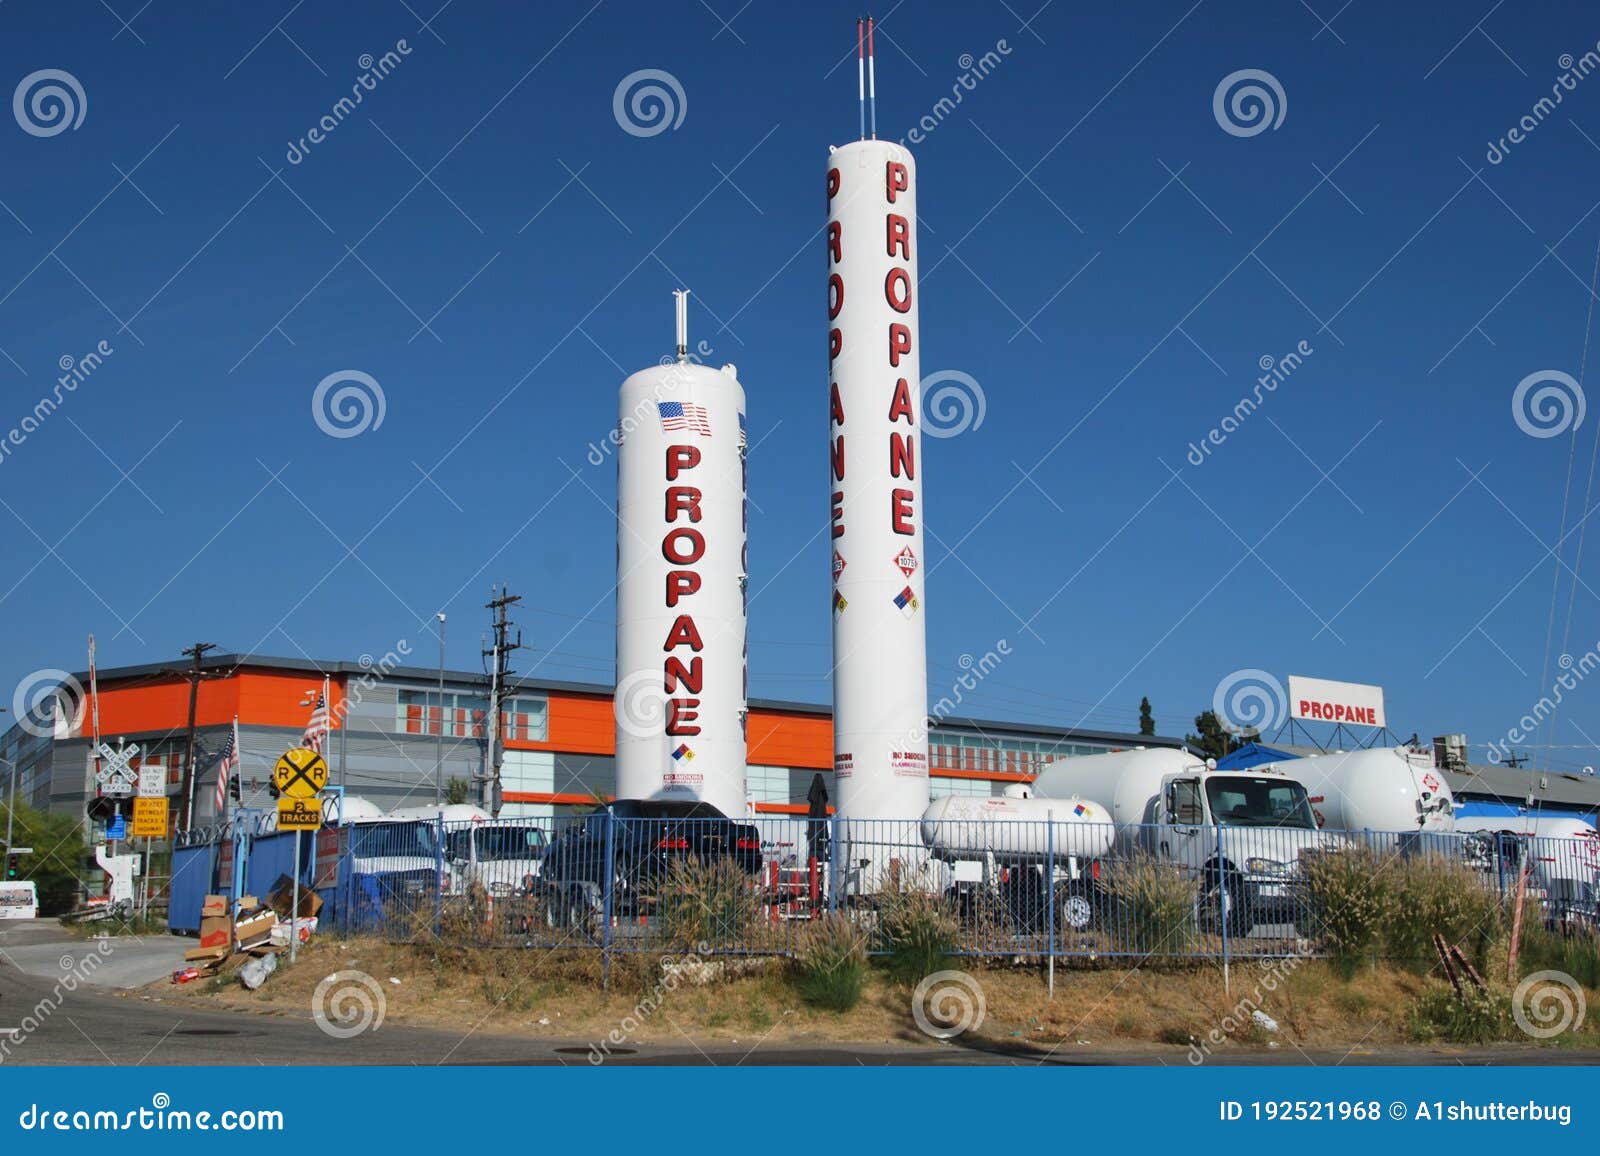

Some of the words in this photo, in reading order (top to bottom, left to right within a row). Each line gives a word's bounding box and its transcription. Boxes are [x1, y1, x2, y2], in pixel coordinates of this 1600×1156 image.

[885, 160, 916, 537] PROPANE
[900, 557, 915, 568] 1075
[661, 444, 706, 738] PROPANE
[1299, 700, 1377, 725] PROPANE
[278, 767, 290, 780] R
[313, 767, 324, 780] R
[295, 801, 305, 814] 2
[281, 813, 317, 824] TRACKS
